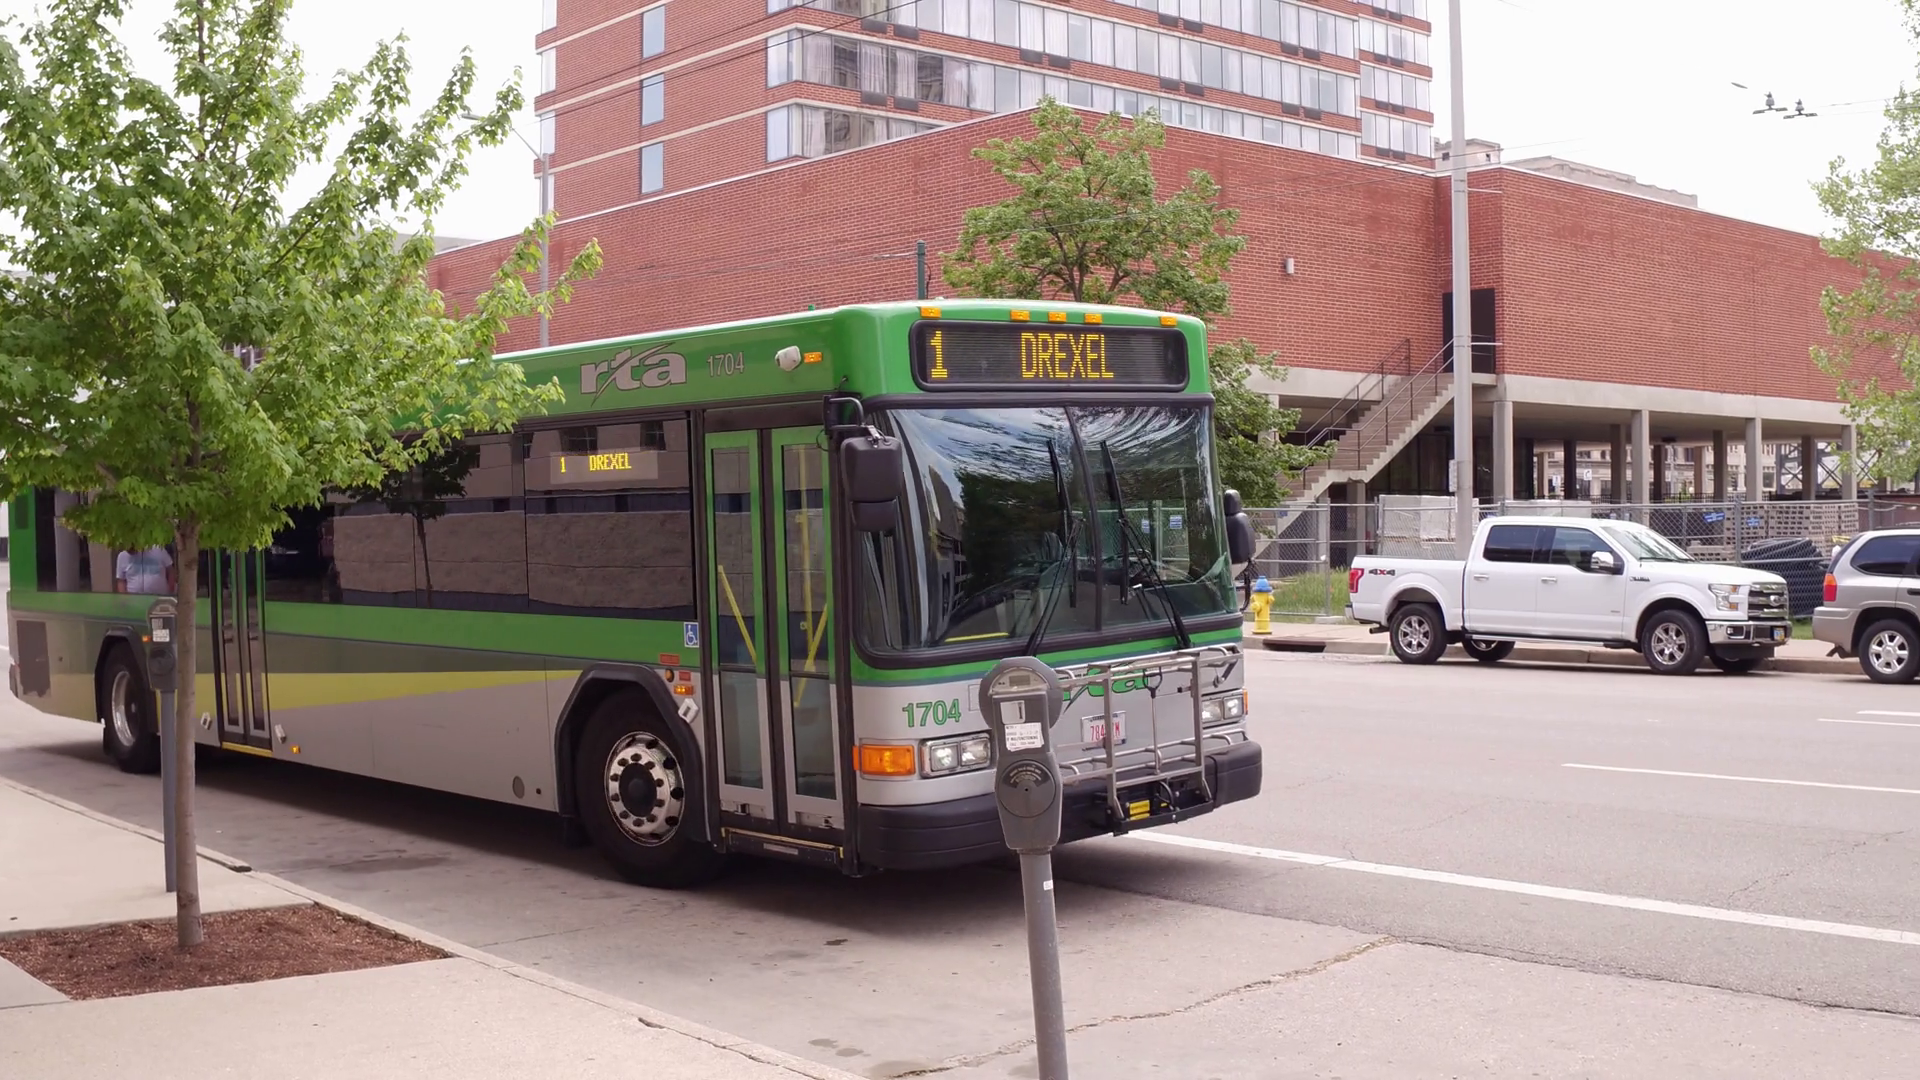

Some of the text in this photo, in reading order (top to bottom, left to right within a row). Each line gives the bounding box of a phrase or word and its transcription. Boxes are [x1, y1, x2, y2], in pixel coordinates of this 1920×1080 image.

[706, 351, 745, 378] 1704
[930, 330, 1114, 379] 1 DREXEL
[580, 345, 688, 400] rta
[560, 452, 632, 473] 1 DREXEL
[901, 698, 962, 728] 1704
